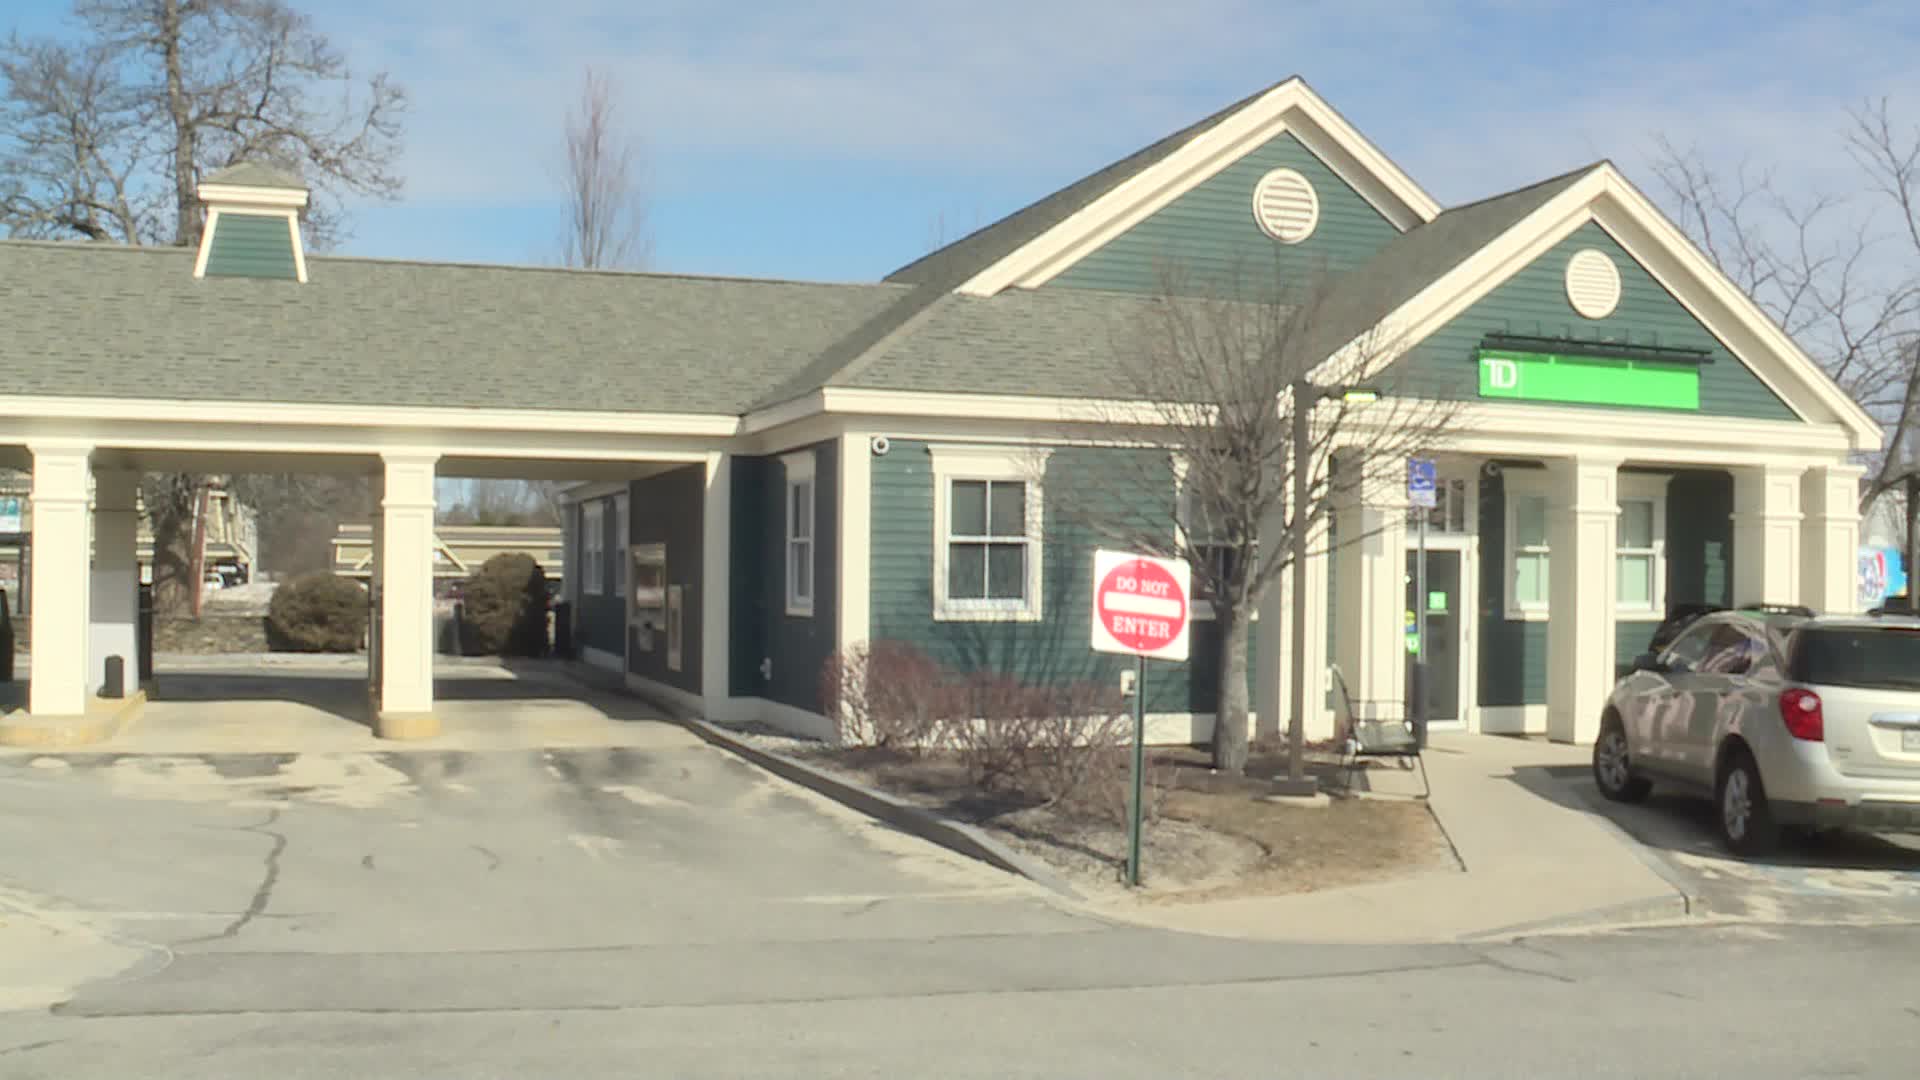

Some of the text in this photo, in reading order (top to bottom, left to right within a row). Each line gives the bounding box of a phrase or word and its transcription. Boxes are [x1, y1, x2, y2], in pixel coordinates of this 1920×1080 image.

[1483, 359, 1517, 388] TD
[1116, 576, 1170, 596] DO NOT
[1113, 615, 1170, 639] ENTER
